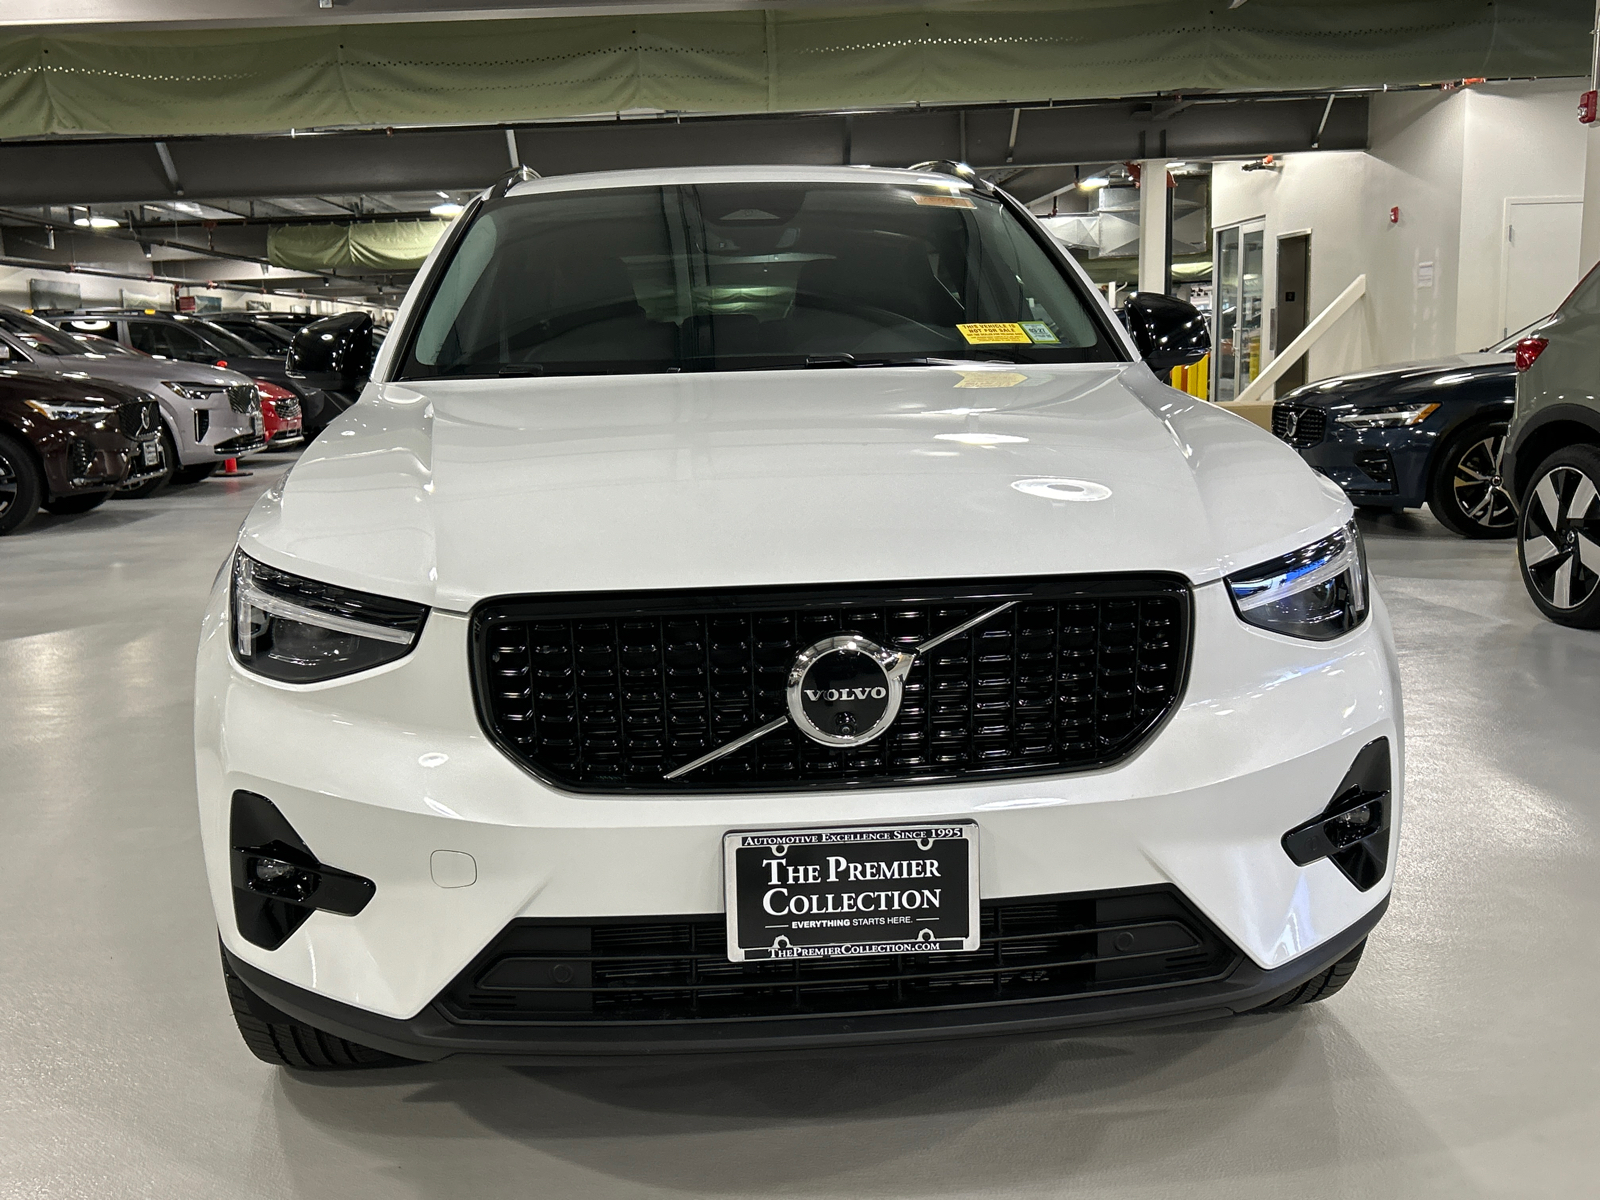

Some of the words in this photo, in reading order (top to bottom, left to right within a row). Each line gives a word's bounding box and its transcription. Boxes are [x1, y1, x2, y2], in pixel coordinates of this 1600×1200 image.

[804, 686, 887, 702] VOLVO
[744, 835, 819, 846] AUTOMOTIVE
[822, 832, 891, 842] EXCELLENCE
[893, 830, 927, 840] SINCE
[930, 828, 961, 838] 1995
[762, 857, 822, 885] THE
[826, 856, 941, 882] PREMIER
[762, 887, 942, 916] COLLECTION
[791, 918, 851, 929] EVERYTHING
[852, 917, 886, 926] STARTS
[887, 916, 913, 925] HERE.
